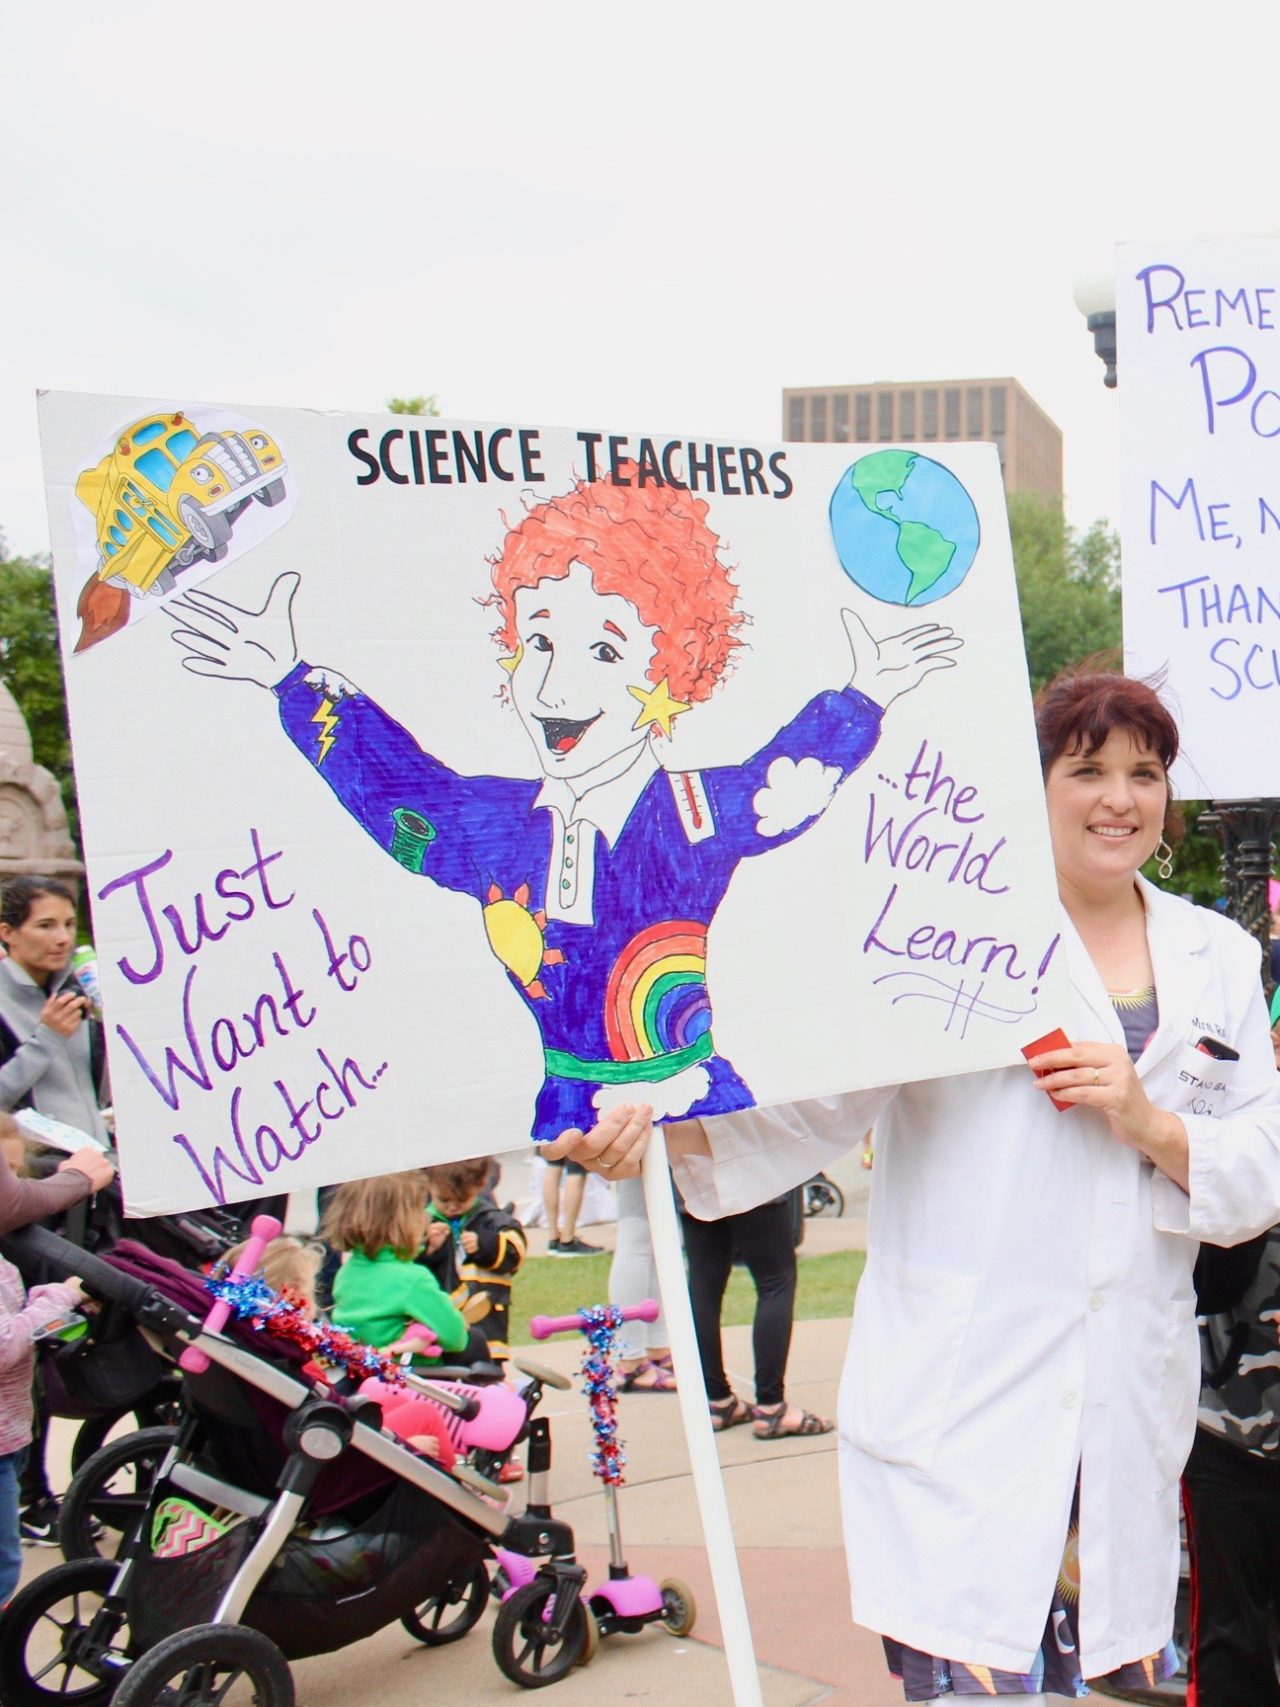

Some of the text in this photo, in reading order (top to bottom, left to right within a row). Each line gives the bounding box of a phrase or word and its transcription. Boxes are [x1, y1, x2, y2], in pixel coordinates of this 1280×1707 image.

[347, 428, 793, 499] SCIENCE TEACHERS
[1150, 478, 1242, 549] ME,
[864, 792, 1011, 894] World
[98, 828, 295, 985] Just
[863, 883, 1061, 995] Learn!
[116, 908, 372, 1111] Want to
